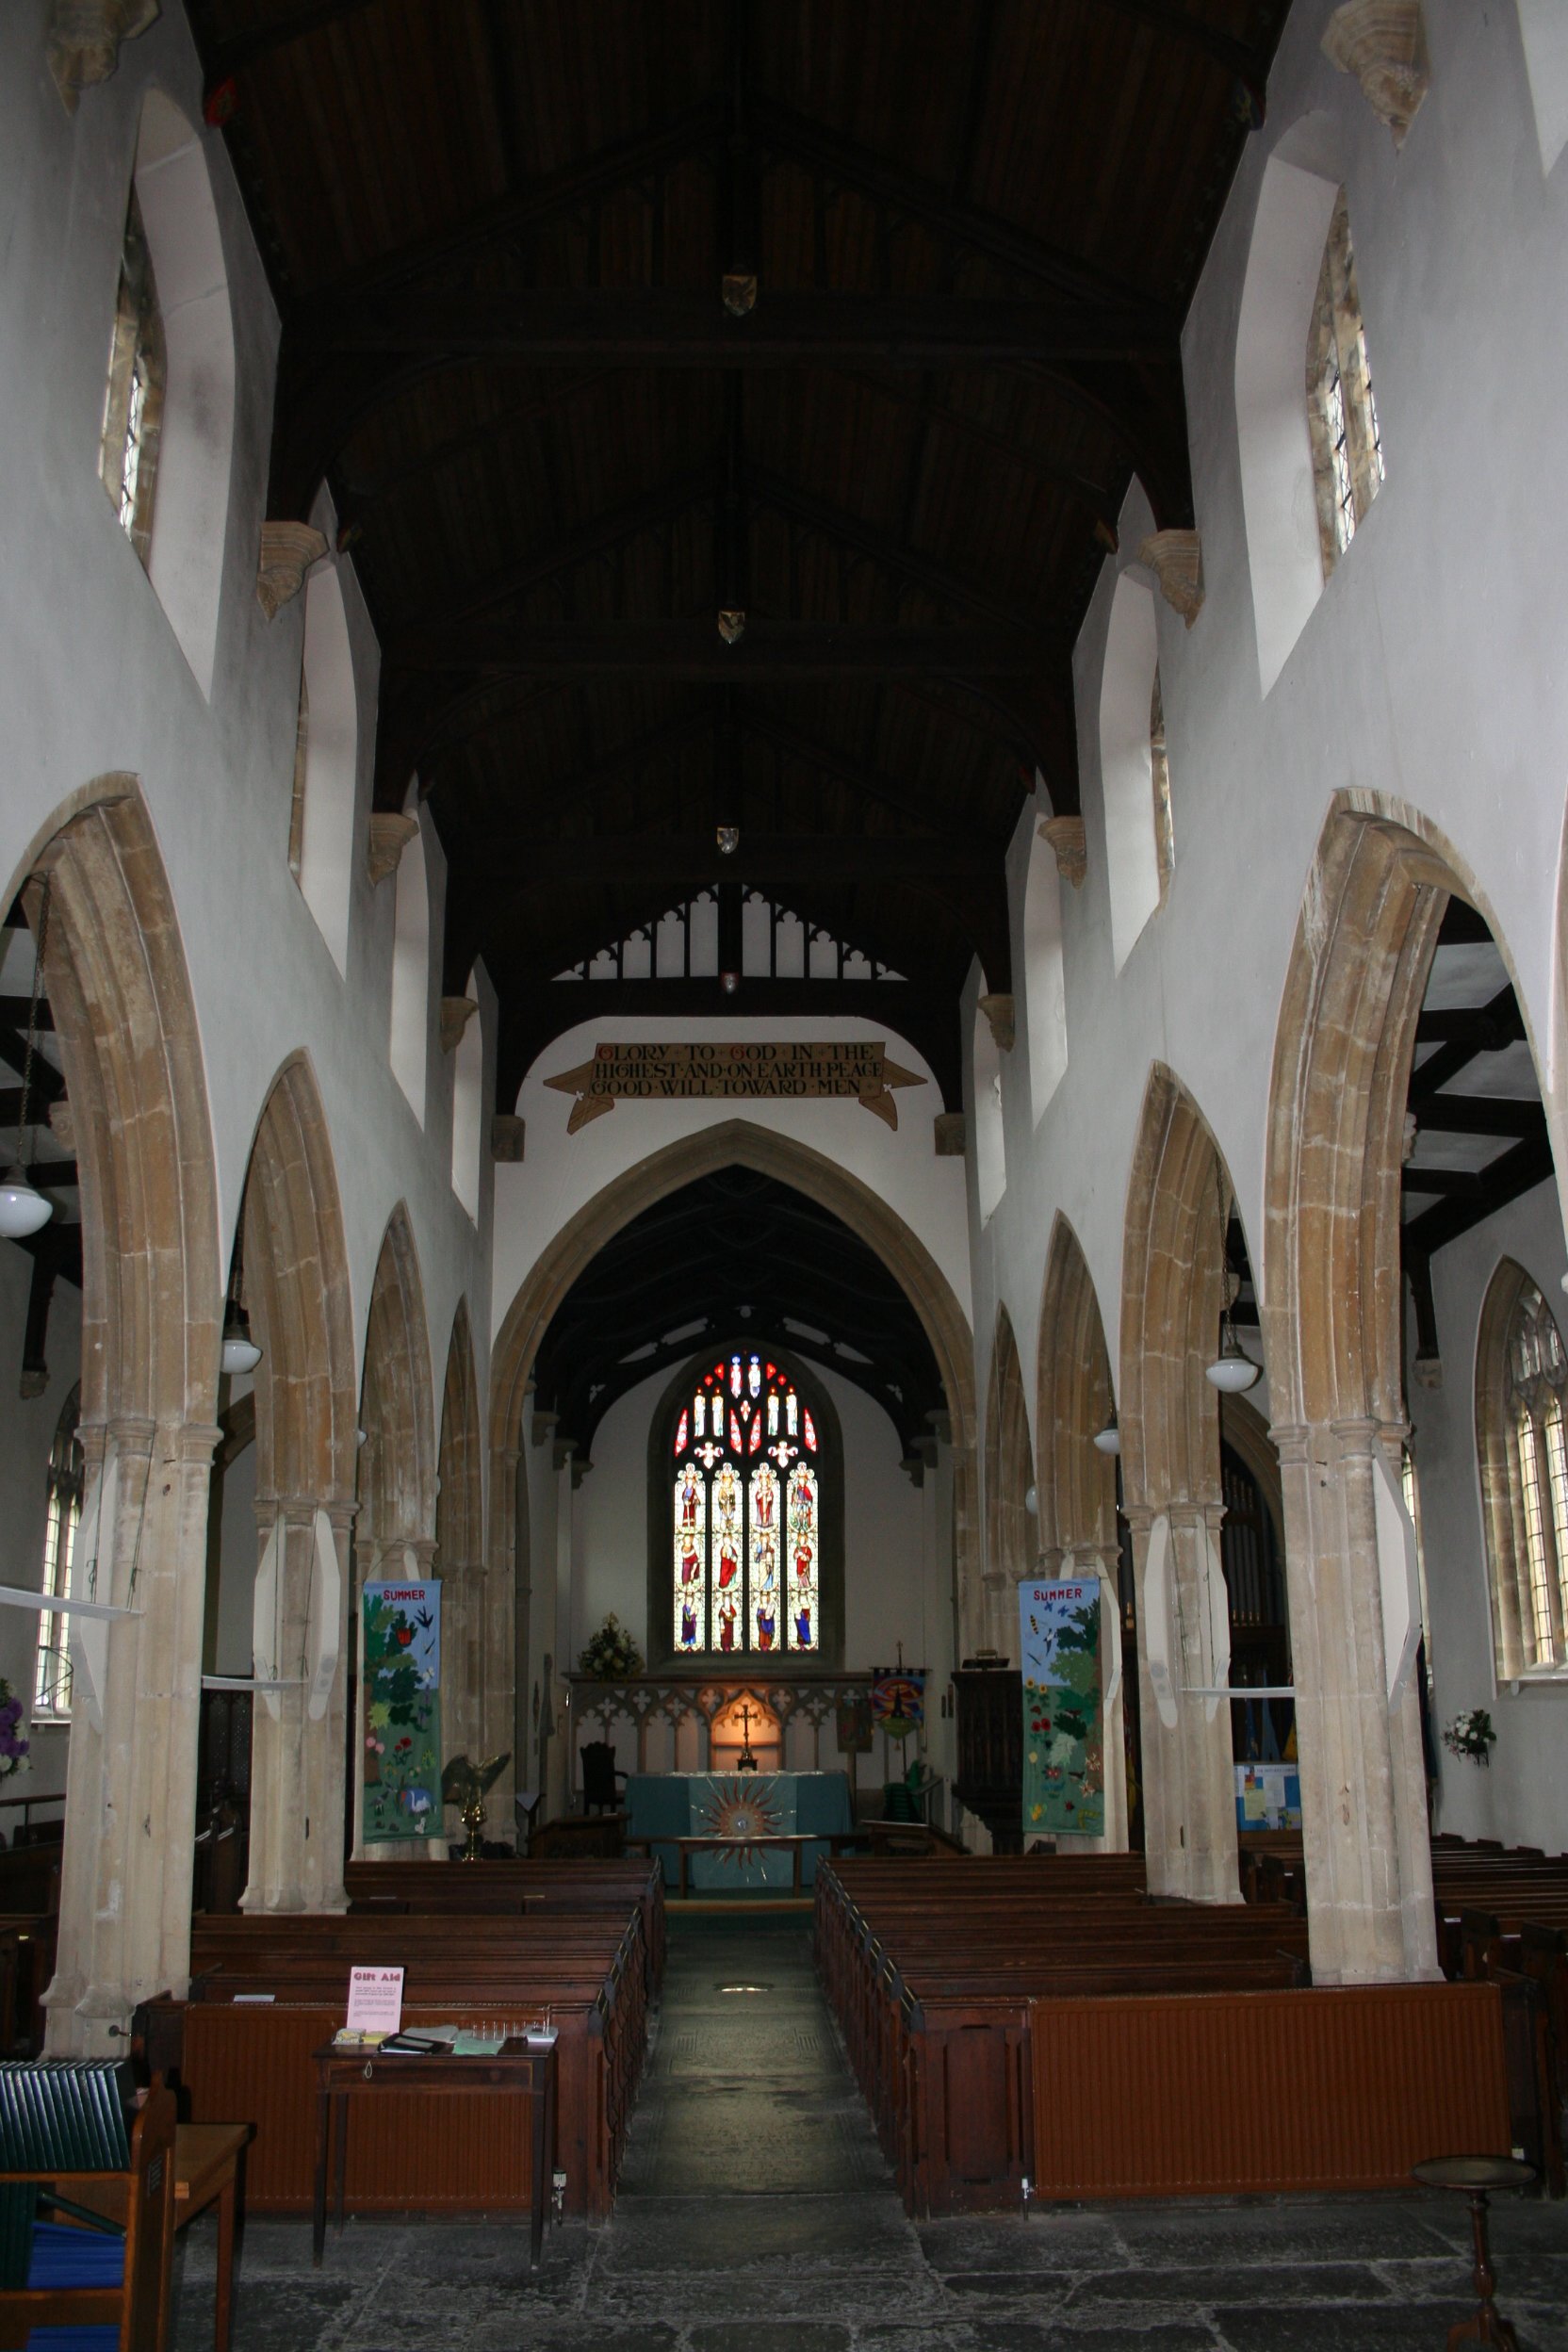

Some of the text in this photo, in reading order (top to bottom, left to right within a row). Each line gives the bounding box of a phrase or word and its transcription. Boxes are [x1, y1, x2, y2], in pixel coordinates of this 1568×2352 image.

[598, 1044, 874, 1061] GLORY TO GOD IN THE
[595, 1062, 882, 1078] HIGHEST AND ON EARTH PEACE
[591, 1079, 860, 1096] GOOD WILL TOWARD MEN
[383, 1590, 426, 1601] SUMMER
[1034, 1588, 1083, 1601] SUMMER
[353, 1971, 400, 1982] Gift Aid
